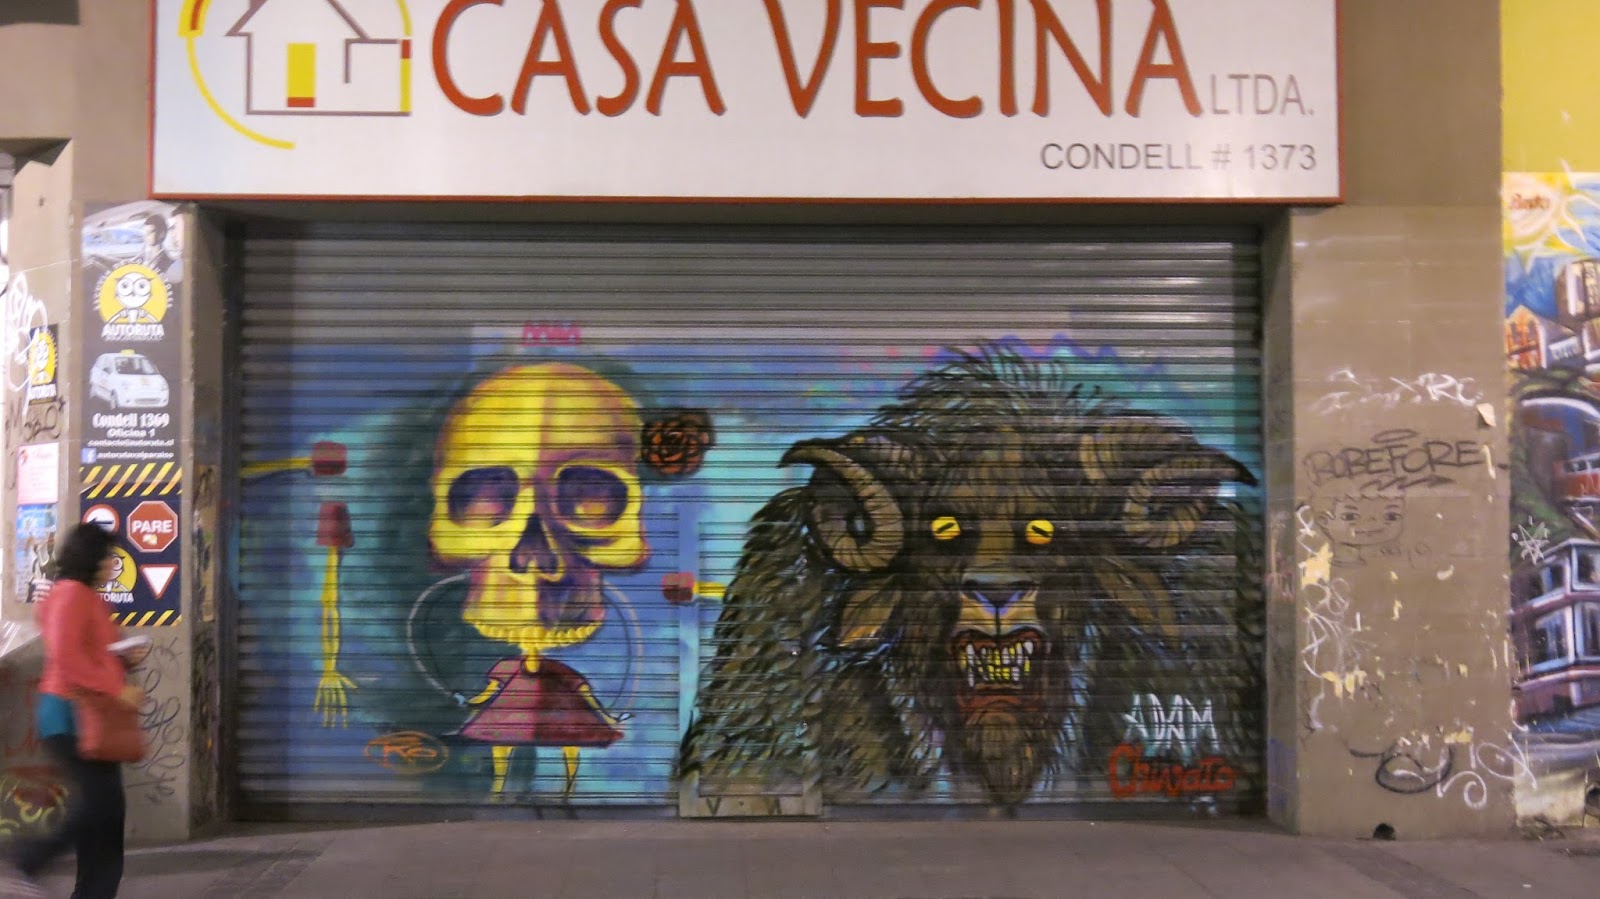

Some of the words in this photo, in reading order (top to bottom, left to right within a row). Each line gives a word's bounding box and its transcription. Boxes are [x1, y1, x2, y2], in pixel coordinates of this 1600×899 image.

[432, 0, 727, 117] CASA
[763, 0, 1202, 119] VECINA
[1209, 74, 1316, 116] LTDA.
[1040, 142, 1203, 171] CONDELL
[1213, 143, 1233, 170] #
[1246, 143, 1318, 171] 1373
[101, 323, 164, 337] AUTORUTA
[92, 412, 138, 429] Condell
[139, 412, 170, 429] 1369
[106, 428, 147, 438] Oficina
[148, 428, 156, 438] 1
[131, 519, 173, 533] PARE
[98, 592, 134, 603] TORUTA
